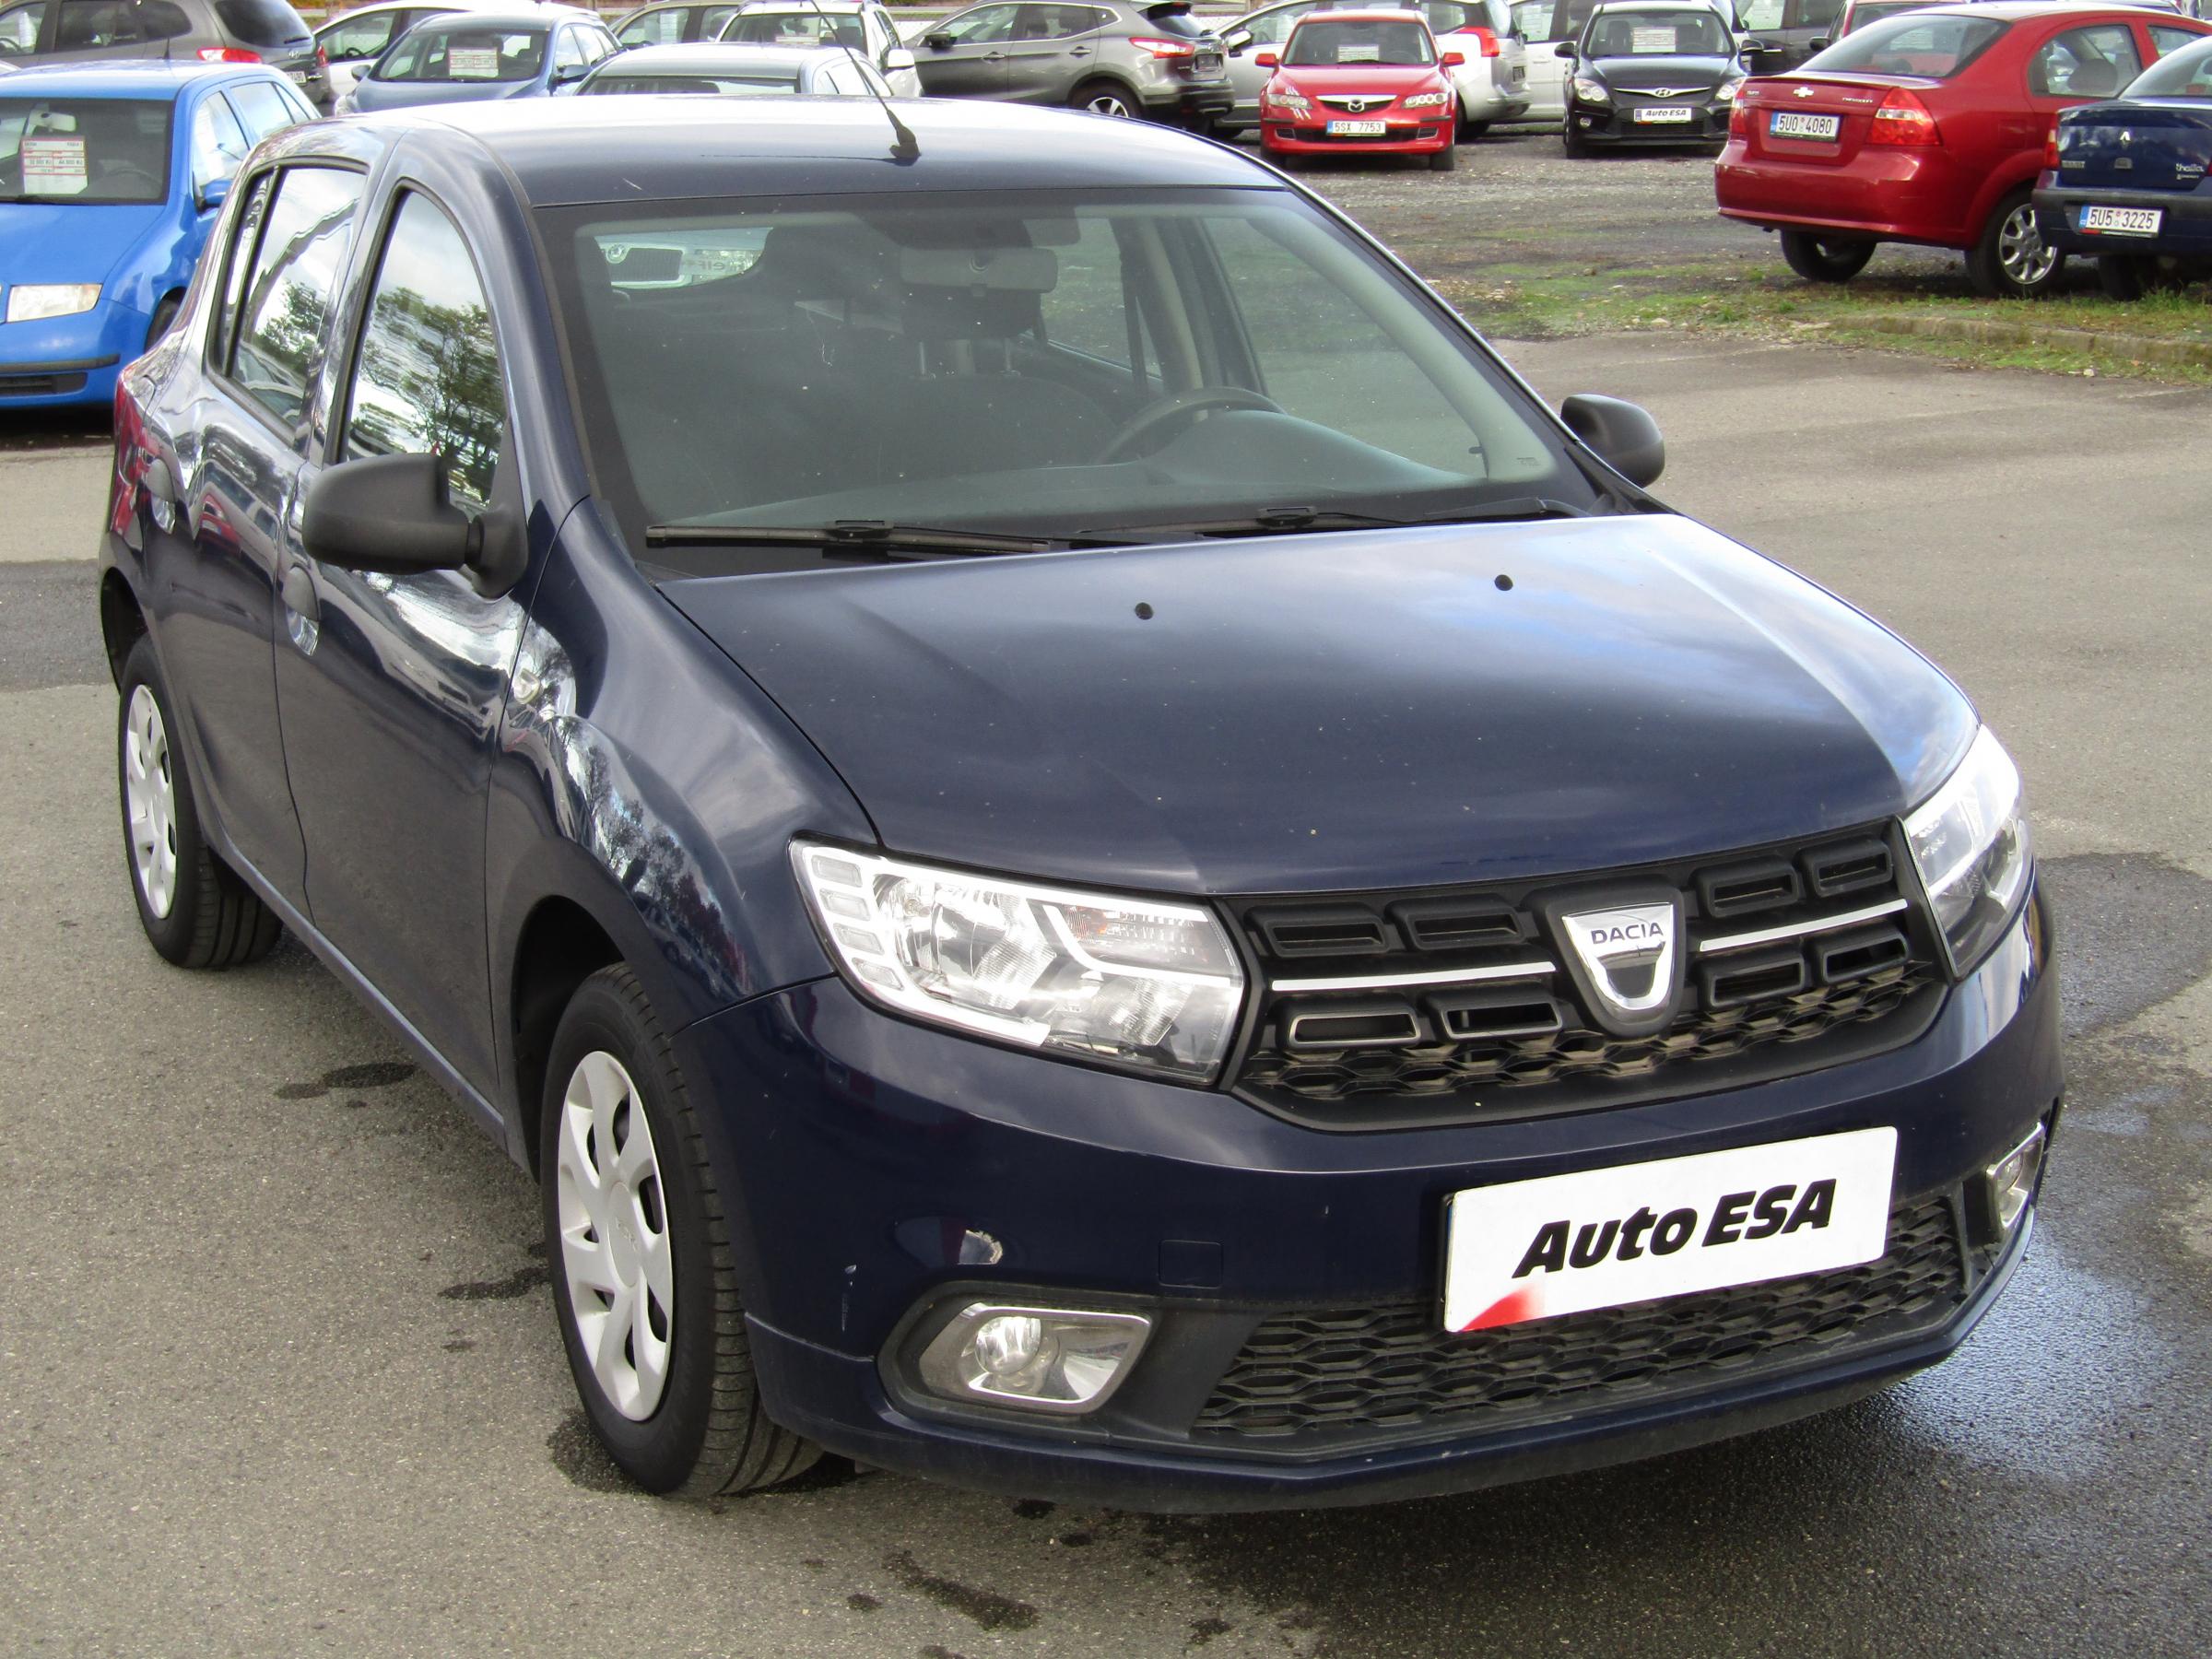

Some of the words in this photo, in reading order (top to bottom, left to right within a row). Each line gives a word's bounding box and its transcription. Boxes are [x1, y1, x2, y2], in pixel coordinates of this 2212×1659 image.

[1335, 122, 1351, 132] 5SX
[1359, 122, 1382, 132] 7753
[1806, 117, 1832, 135] 4080
[2089, 208, 2114, 226] 5U5
[2122, 211, 2155, 229] 3225
[1590, 922, 1665, 945] DACIA
[1511, 1206, 1699, 1279] Auto
[1701, 1178, 1838, 1248] ESA
